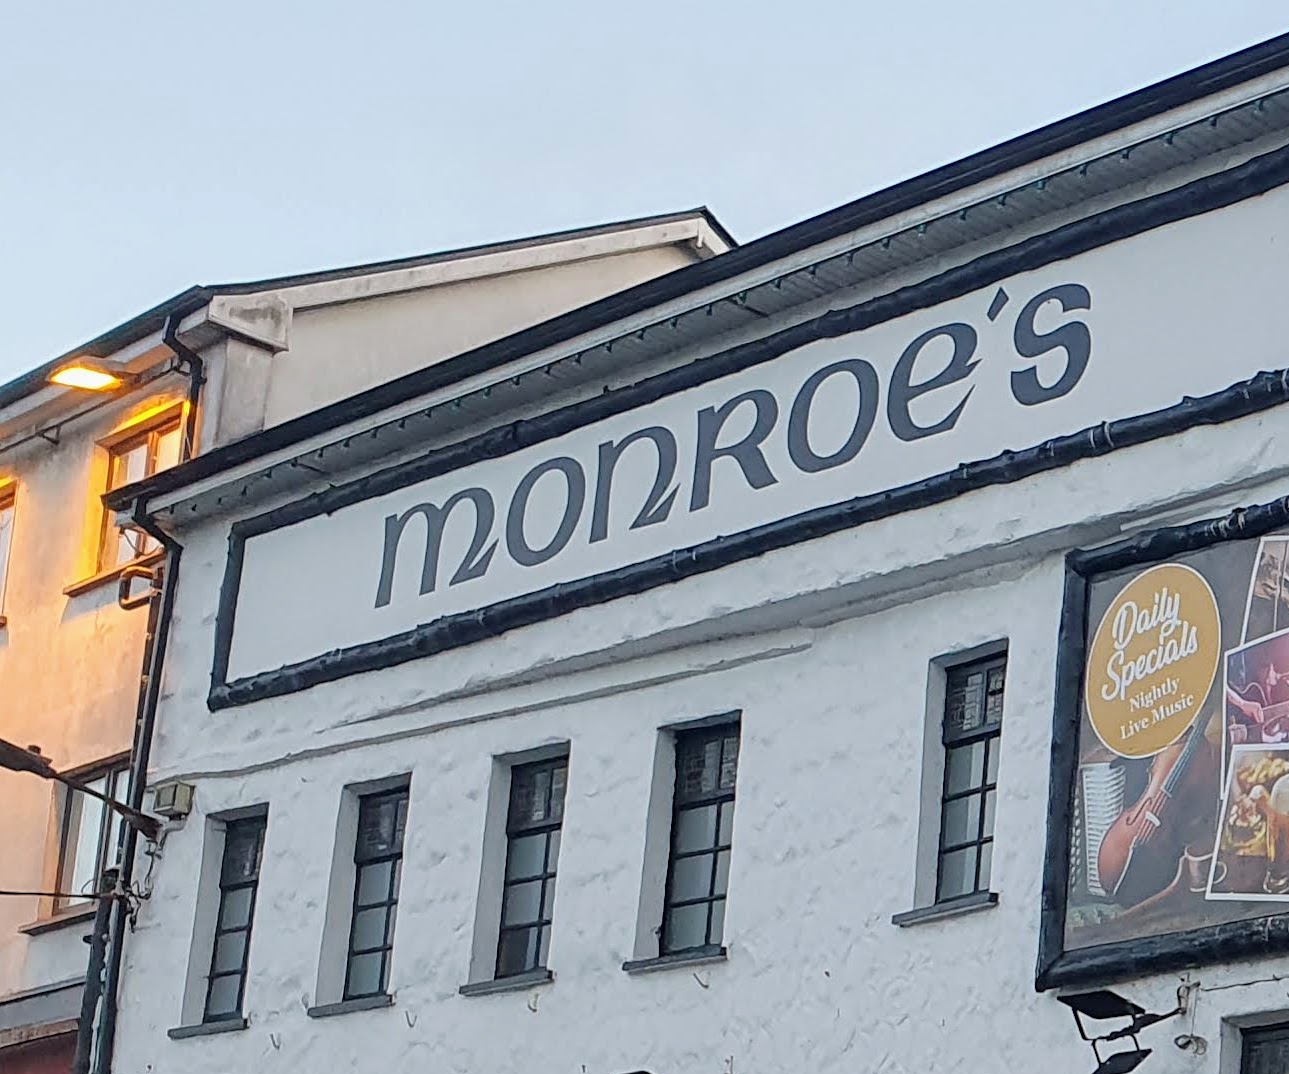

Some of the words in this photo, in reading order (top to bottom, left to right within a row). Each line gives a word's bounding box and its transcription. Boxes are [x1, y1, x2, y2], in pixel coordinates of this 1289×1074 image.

[1112, 586, 1181, 649] Daily
[1101, 622, 1198, 700] Specials
[1120, 716, 1149, 740] Live
[1151, 694, 1194, 728] Music
[1129, 676, 1180, 712] Nightly
